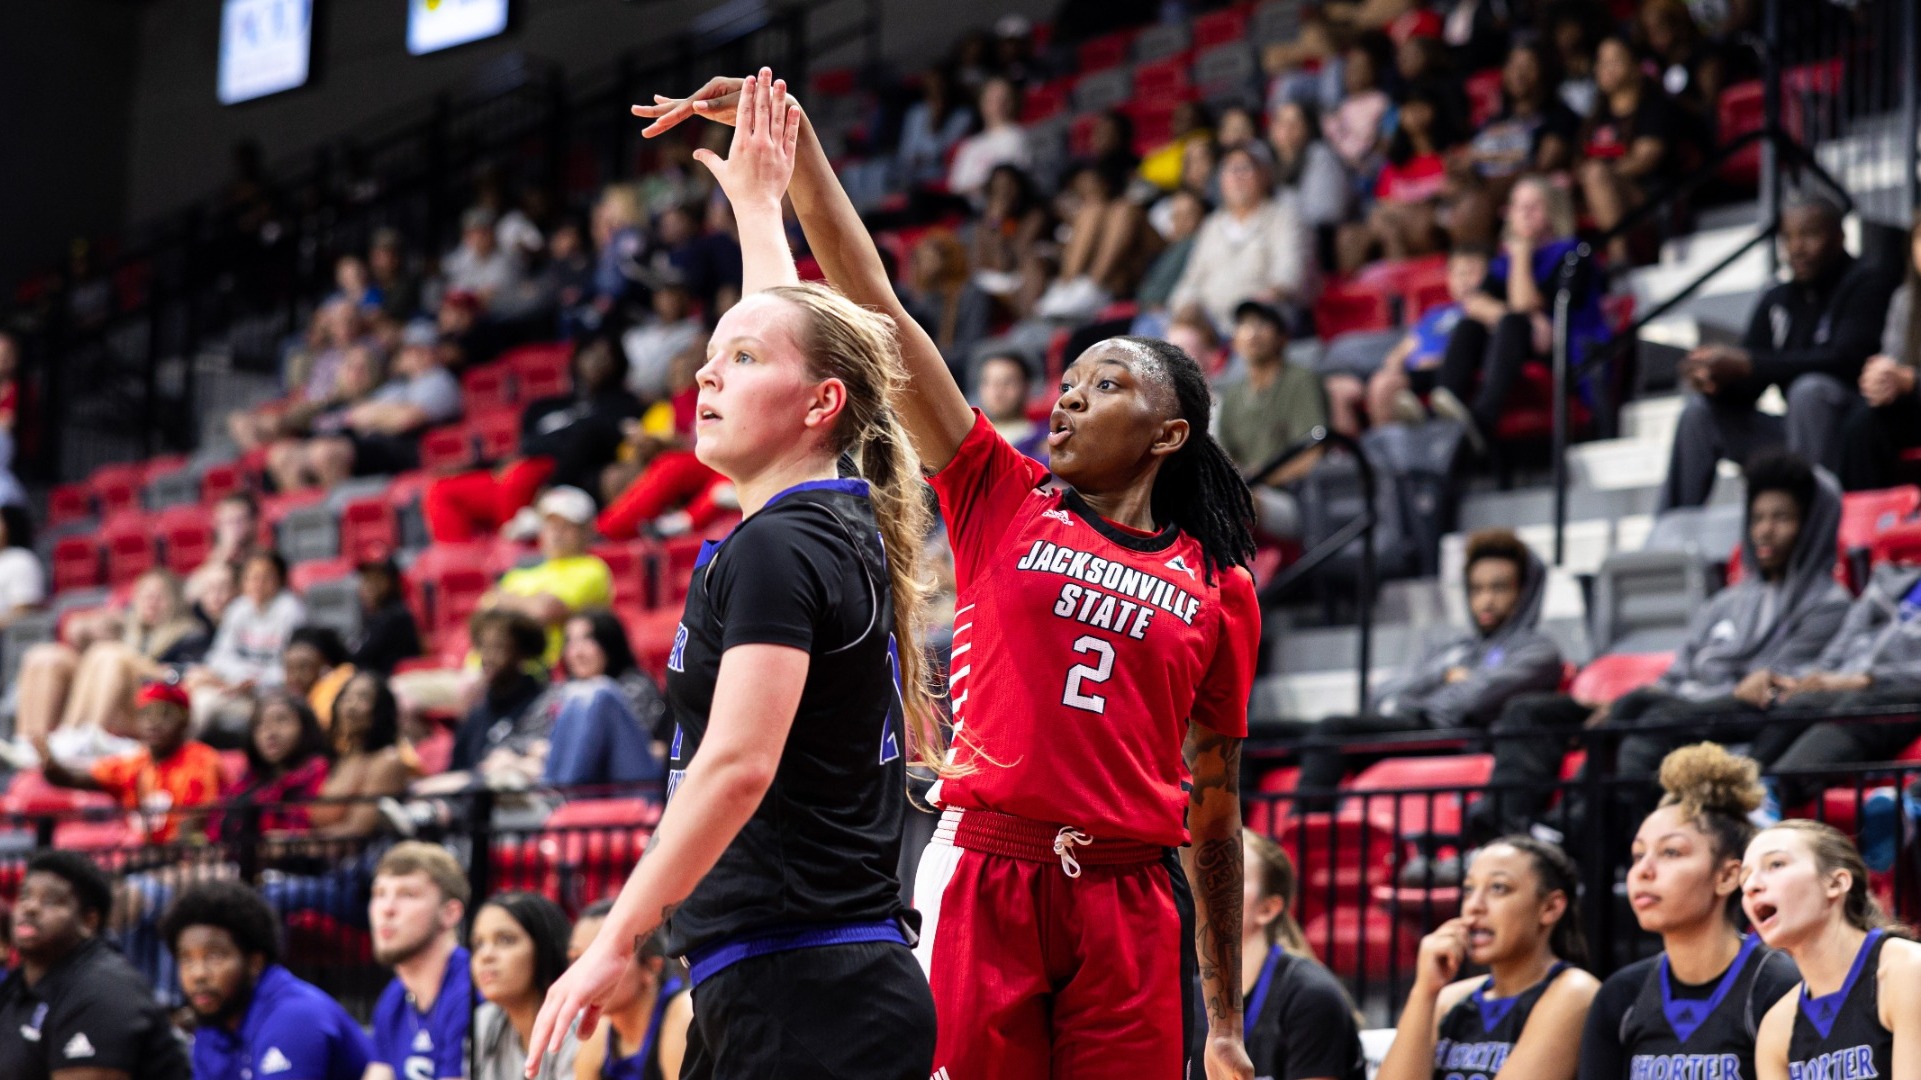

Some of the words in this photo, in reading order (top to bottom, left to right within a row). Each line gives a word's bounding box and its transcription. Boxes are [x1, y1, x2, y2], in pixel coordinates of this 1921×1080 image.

[1016, 539, 1200, 627] JACKSONVILLE
[1053, 582, 1155, 641] STATE
[1062, 634, 1117, 714] 2
[1789, 1044, 1879, 1080] HORTER
